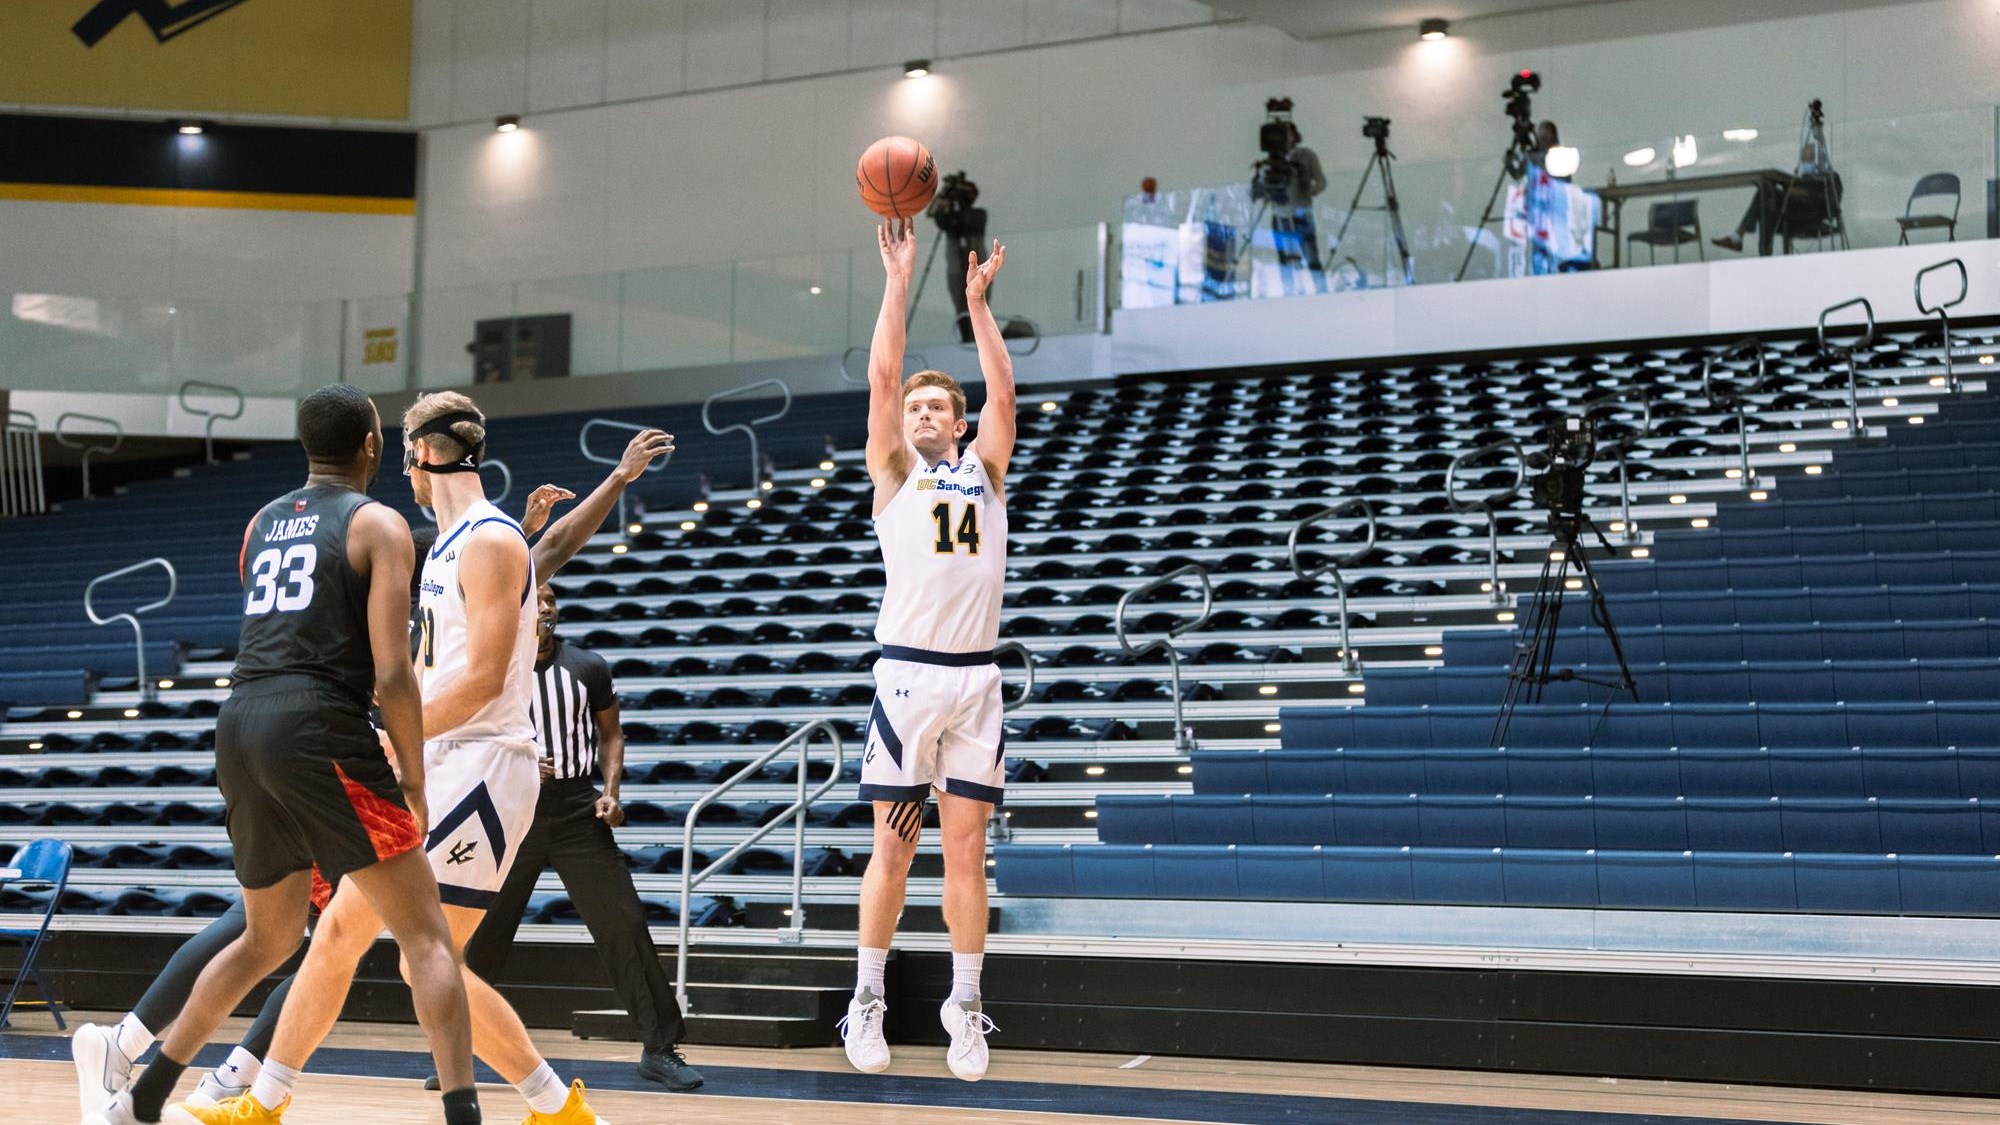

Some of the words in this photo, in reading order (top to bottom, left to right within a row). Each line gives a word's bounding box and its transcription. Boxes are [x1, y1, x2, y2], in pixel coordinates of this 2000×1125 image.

[264, 515, 320, 542] JAMES
[931, 501, 980, 557] 14
[245, 543, 318, 616] 33
